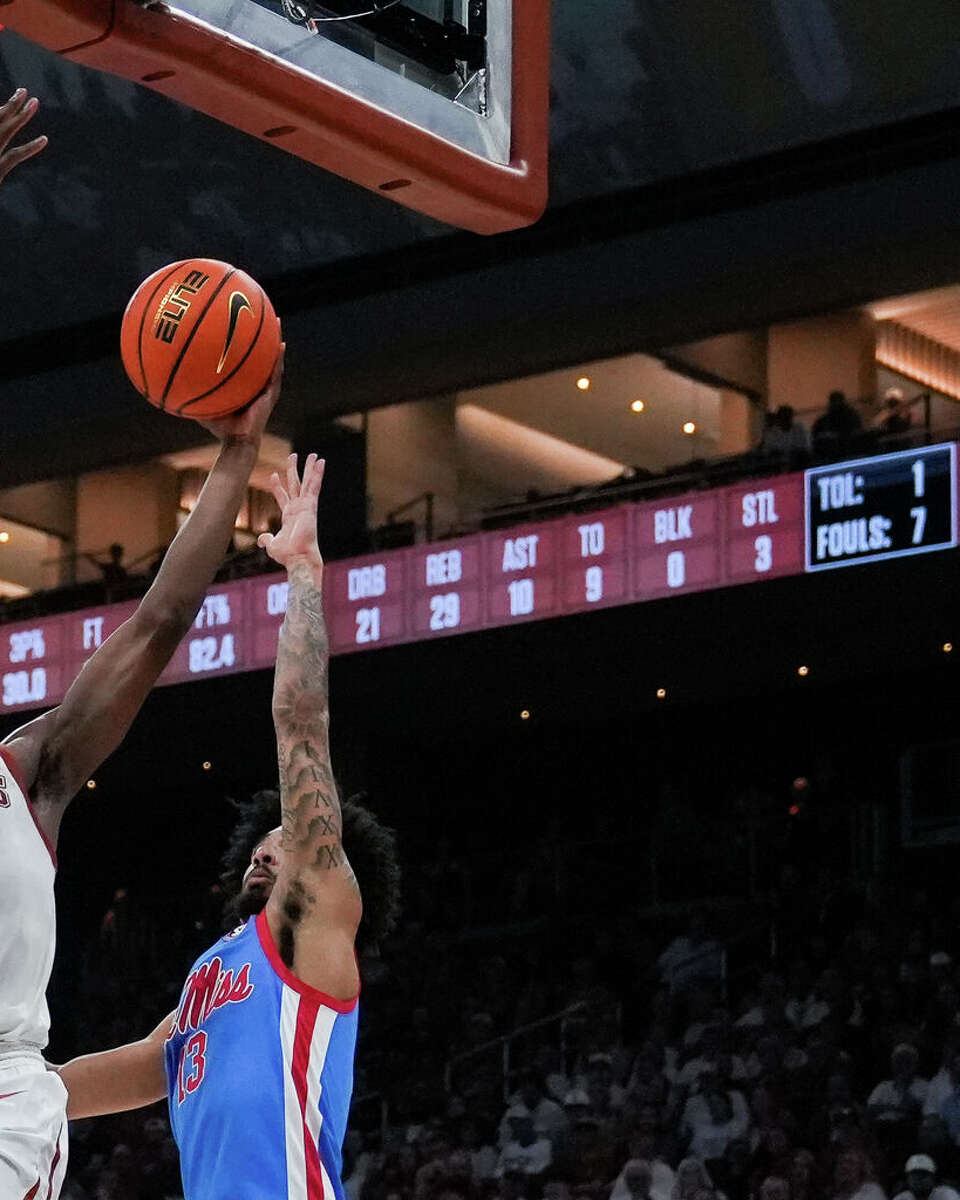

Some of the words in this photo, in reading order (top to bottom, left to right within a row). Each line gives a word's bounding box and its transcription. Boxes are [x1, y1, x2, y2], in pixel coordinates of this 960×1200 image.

[154, 270, 210, 344] ELITE
[817, 472, 864, 511] TOL:
[912, 460, 925, 497] 1
[426, 549, 462, 586] REB
[502, 534, 539, 572] AST
[578, 522, 604, 557] TO
[654, 505, 692, 544] BLK
[742, 489, 779, 527] STL
[816, 514, 892, 560] FOULS:
[910, 506, 927, 544] 7
[356, 607, 380, 643] 21
[430, 592, 460, 631] 29
[508, 578, 534, 616] 10
[585, 565, 603, 602] 9
[667, 551, 685, 588] 0
[754, 535, 772, 572] 3
[178, 956, 254, 1034] Miss
[177, 1030, 208, 1107] 13
